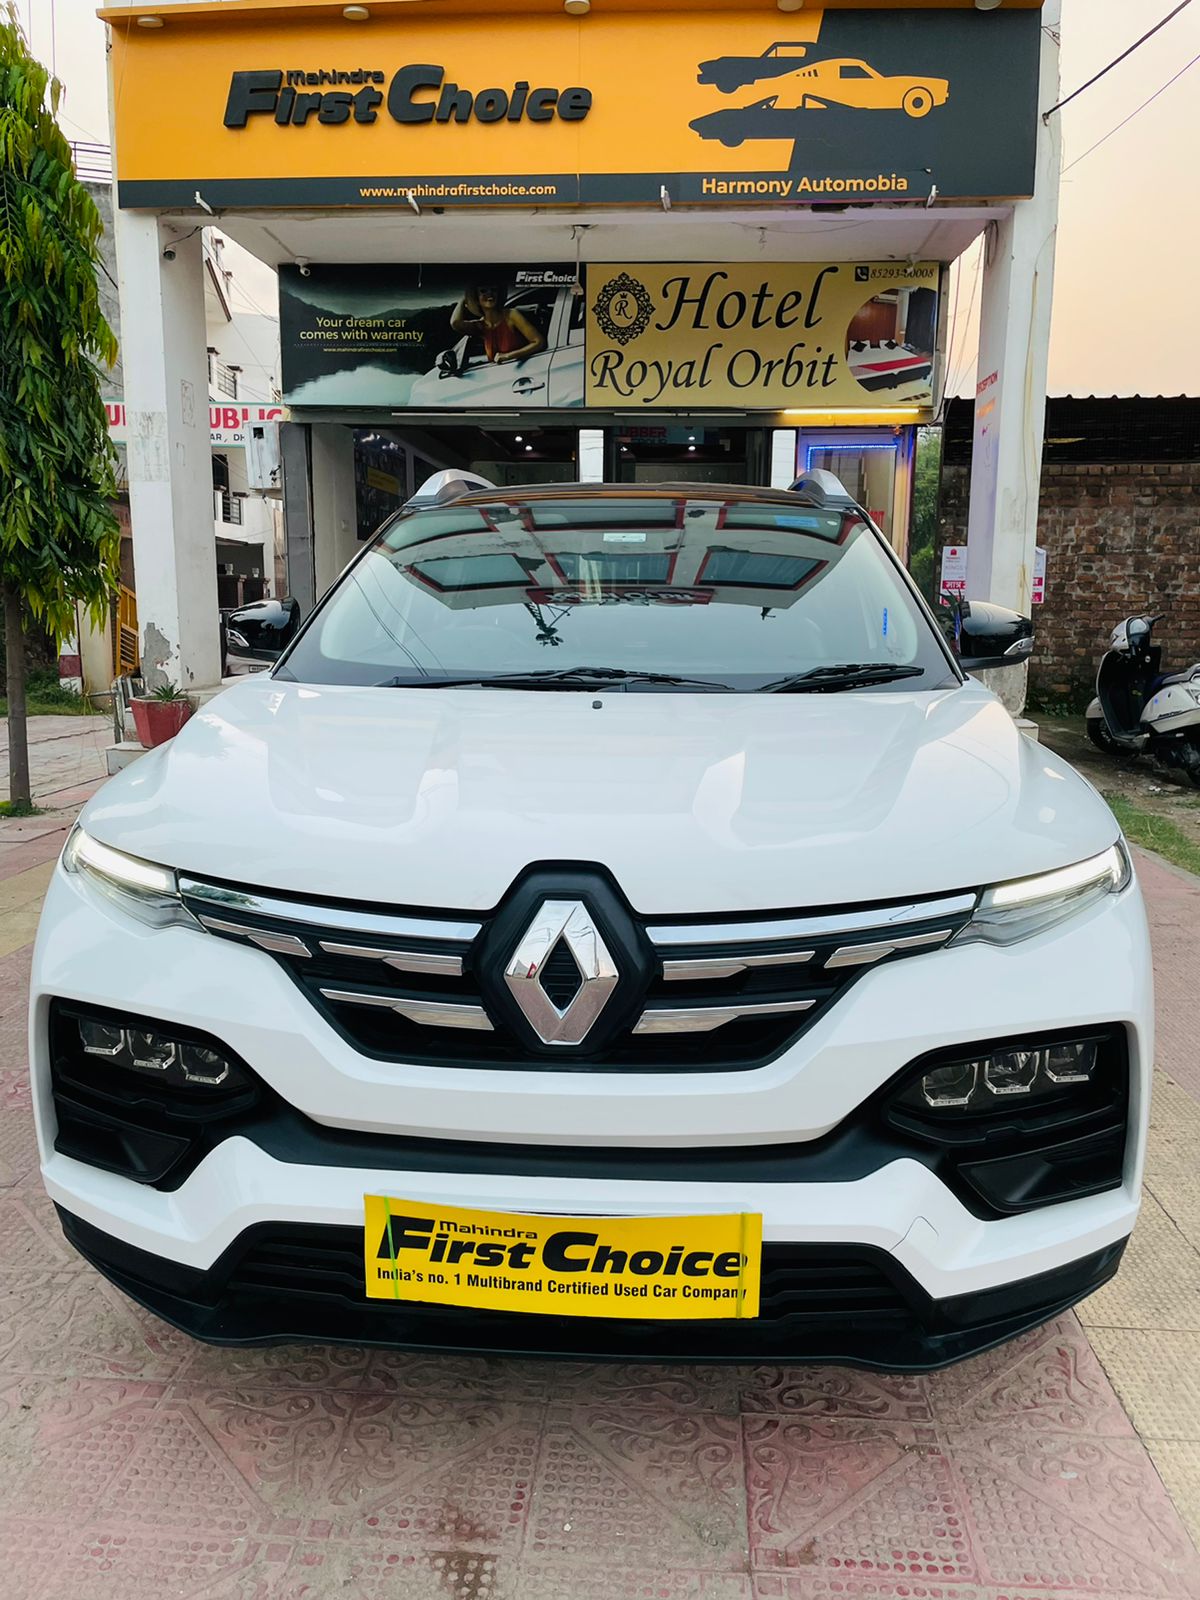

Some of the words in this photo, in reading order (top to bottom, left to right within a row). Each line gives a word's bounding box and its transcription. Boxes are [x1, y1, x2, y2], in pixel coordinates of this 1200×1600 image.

[286, 68, 384, 86] Mahindra
[223, 69, 384, 129] First
[387, 63, 593, 125] Choice
[359, 183, 557, 198] www.mahindrafirstchoice.com
[702, 177, 793, 197] Harmony
[797, 173, 908, 193] Automobia
[515, 271, 543, 282] First
[655, 266, 839, 331] Hotel
[316, 317, 342, 328] Your
[345, 317, 385, 328] dream
[387, 318, 407, 328] car
[300, 331, 339, 340] comes
[341, 329, 368, 340] with
[370, 330, 424, 342] warranty
[590, 342, 723, 403] Royal
[727, 343, 838, 388] Orbit
[439, 1220, 538, 1239] Mahindra
[376, 1214, 538, 1269] First
[541, 1231, 749, 1277] Choice
[377, 1267, 424, 1283] India's
[428, 1273, 449, 1285] no.
[454, 1274, 461, 1286] 1
[467, 1274, 543, 1293] Multibrand
[547, 1279, 609, 1296] Certified
[614, 1283, 648, 1298] Used
[653, 1284, 678, 1298] Car
